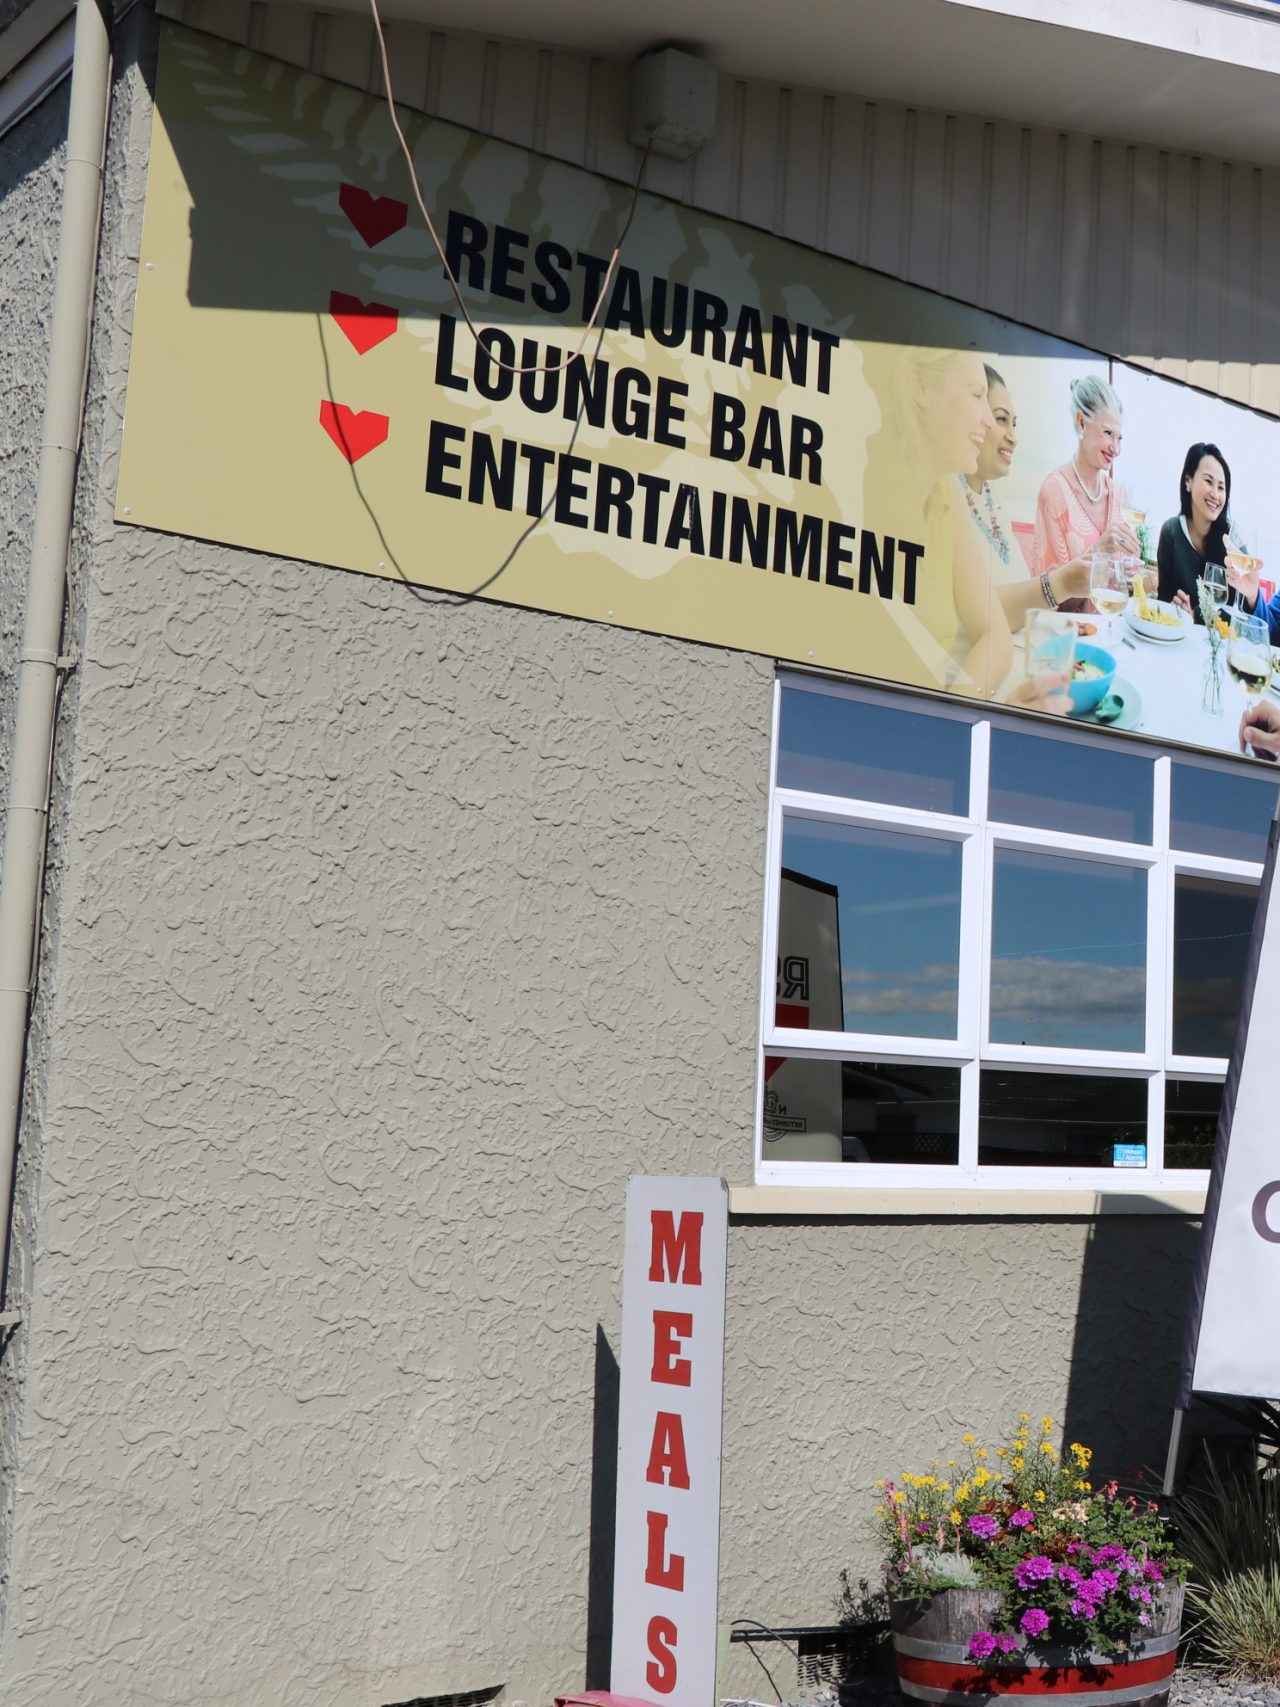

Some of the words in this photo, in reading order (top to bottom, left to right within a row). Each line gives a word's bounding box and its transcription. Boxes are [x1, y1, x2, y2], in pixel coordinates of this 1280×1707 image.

[443, 209, 841, 394] RESTAURANT
[435, 314, 690, 450] LOUNGE
[710, 395, 825, 485] BAR
[425, 420, 925, 605] ENTERTAINMENT
[645, 1210, 704, 1694] MEALS
